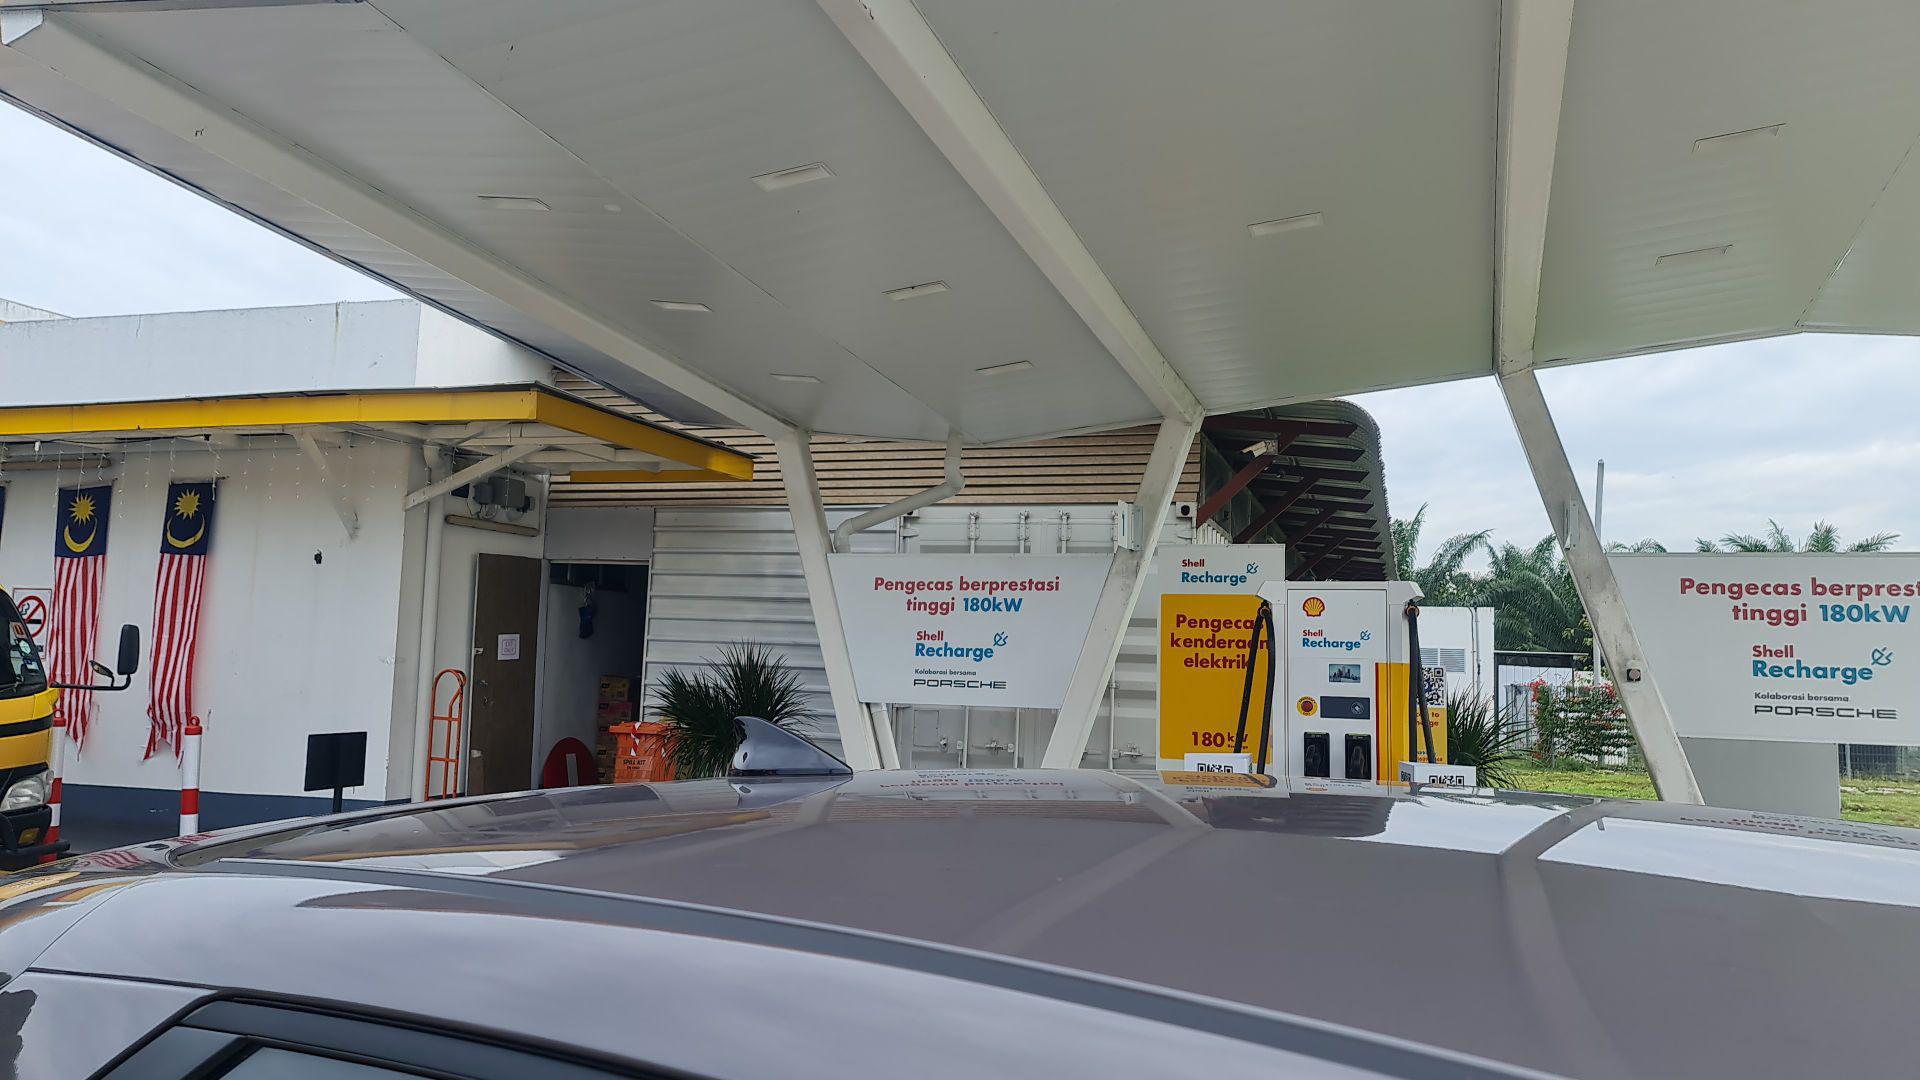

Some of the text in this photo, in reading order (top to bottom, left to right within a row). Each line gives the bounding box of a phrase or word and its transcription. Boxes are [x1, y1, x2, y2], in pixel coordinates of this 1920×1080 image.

[1182, 559, 1205, 567] Shell
[874, 576, 1060, 595] Pengecas berprestasi
[1181, 571, 1247, 586] Recharge
[1680, 578, 1802, 600] Pengecas
[906, 597, 1022, 616] tinggi 180kW
[1732, 603, 1910, 626] tinggi 180kW
[916, 630, 944, 641] Shell
[1302, 637, 1361, 651] Recharge
[915, 642, 994, 662] Recharge
[1752, 645, 1794, 658] Shell
[915, 668, 947, 676] Kolaborasi
[1752, 660, 1873, 684] Recharge
[914, 679, 1007, 689] PORSCHE
[1754, 692, 1849, 702] Kolaborasi bersama
[1754, 705, 1898, 719] PORSCHE
[1191, 731, 1225, 748] 180
